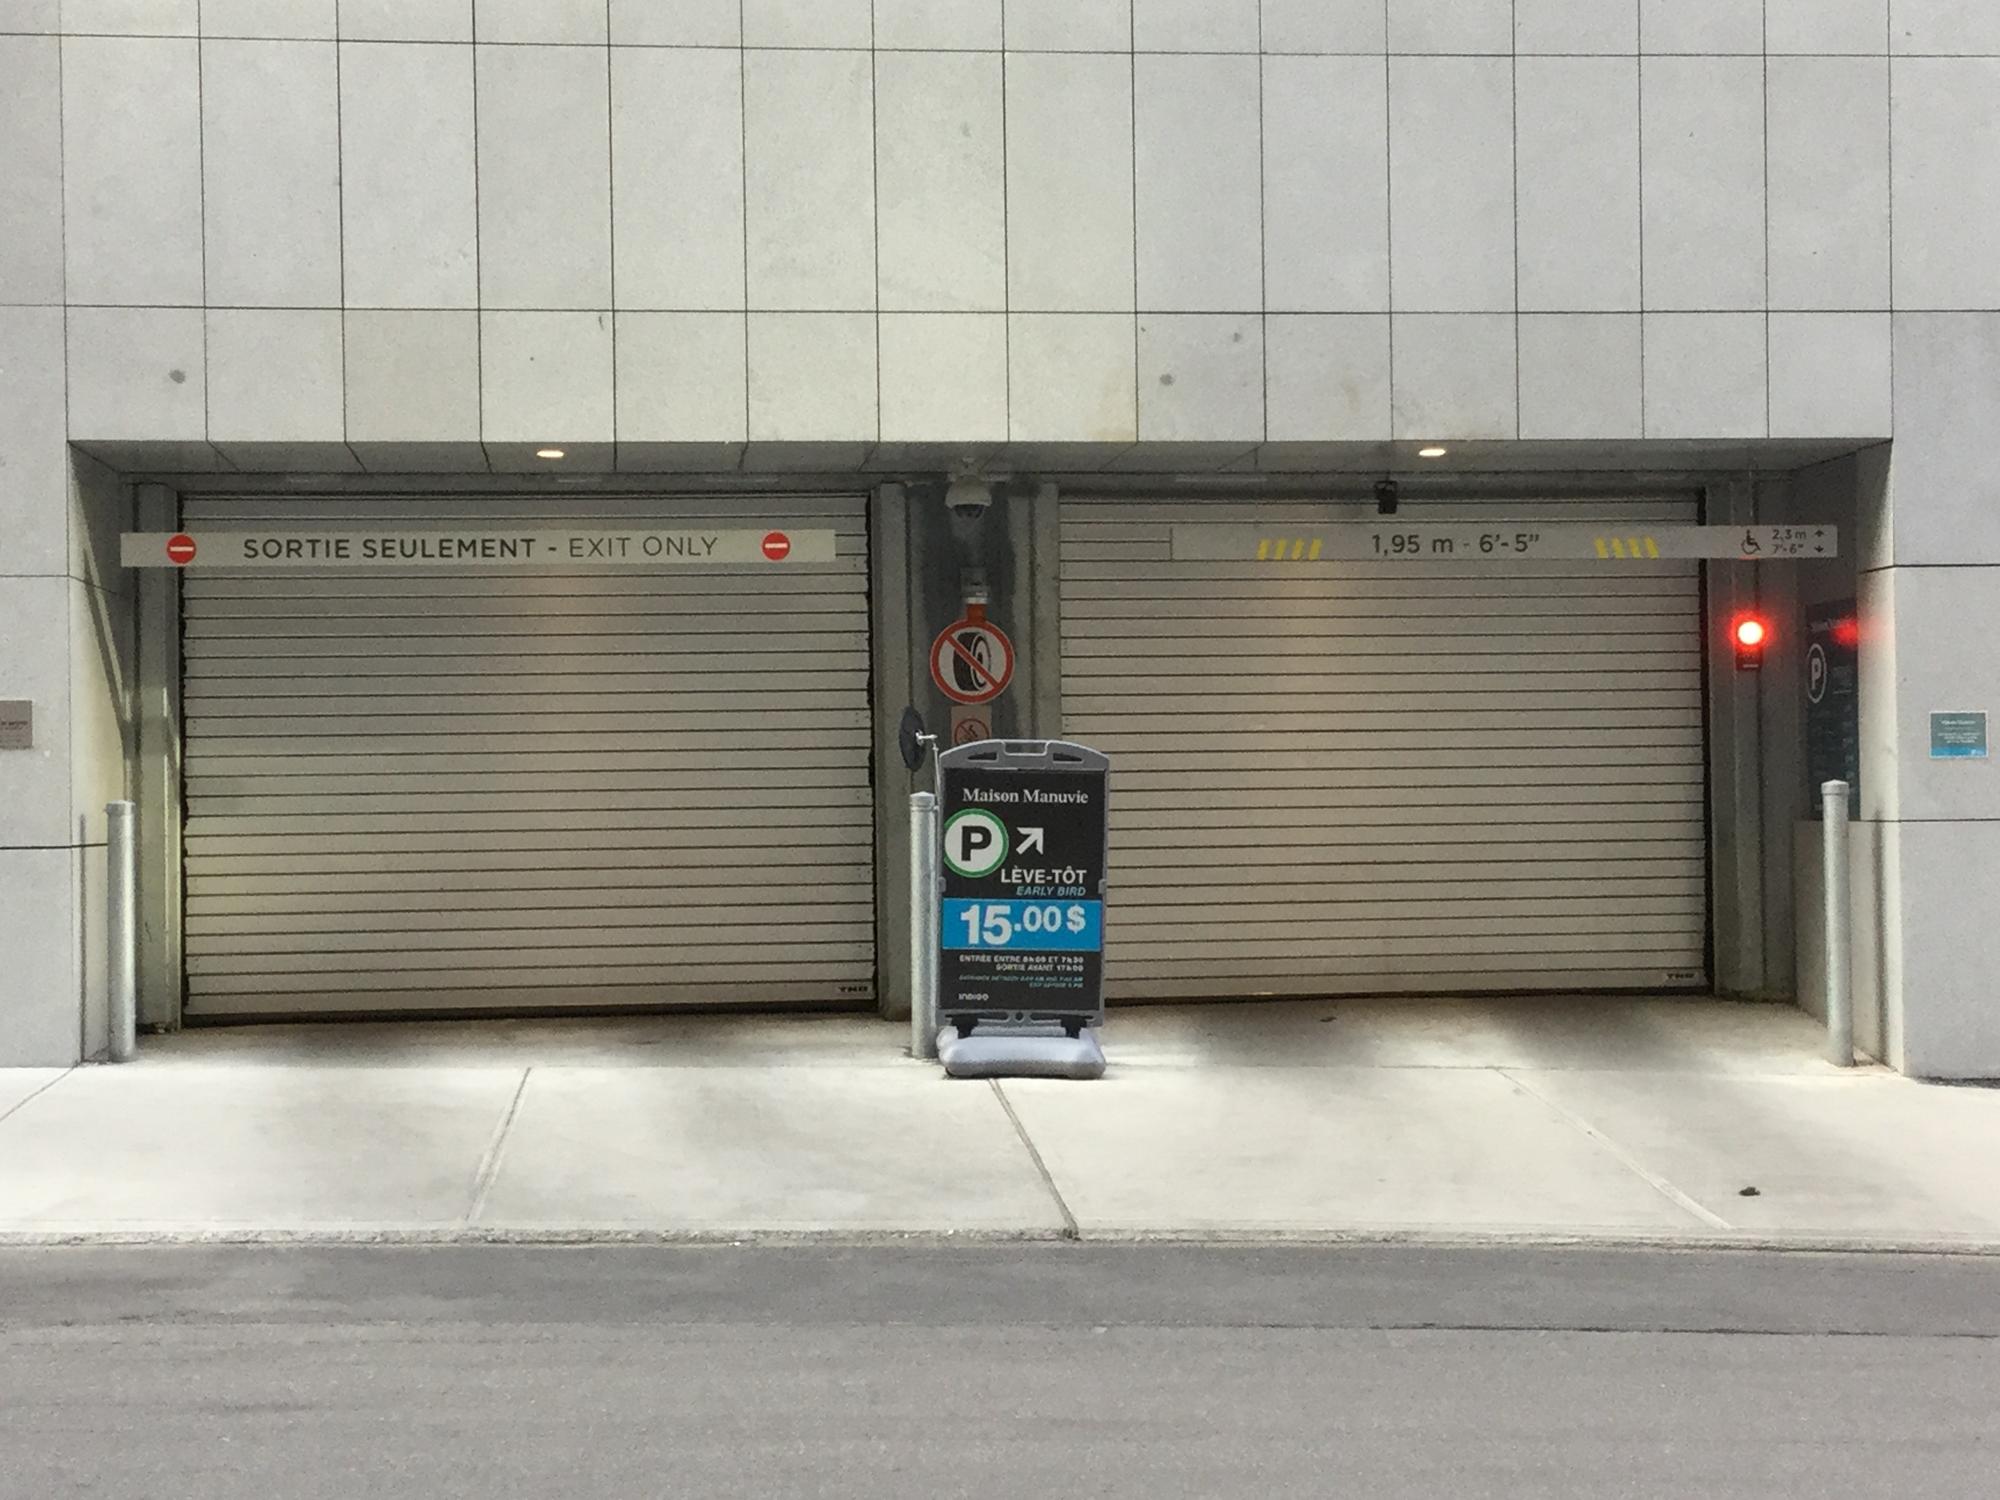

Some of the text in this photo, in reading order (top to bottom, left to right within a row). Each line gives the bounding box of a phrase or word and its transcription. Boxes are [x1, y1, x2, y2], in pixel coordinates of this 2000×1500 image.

[243, 539, 351, 559] SORTIE
[362, 538, 536, 558] SEULEMENT
[569, 537, 631, 557] EXIT
[642, 536, 718, 556] ONLY
[1372, 534, 1420, 556] 1,95
[1432, 538, 1453, 553] m
[1811, 658, 1822, 690] P
[962, 788, 1089, 804] Maison Manuvie
[961, 825, 992, 861] P
[1000, 865, 1087, 884] LÈVE-TÔT
[1016, 886, 1086, 897] EARLY BIRD
